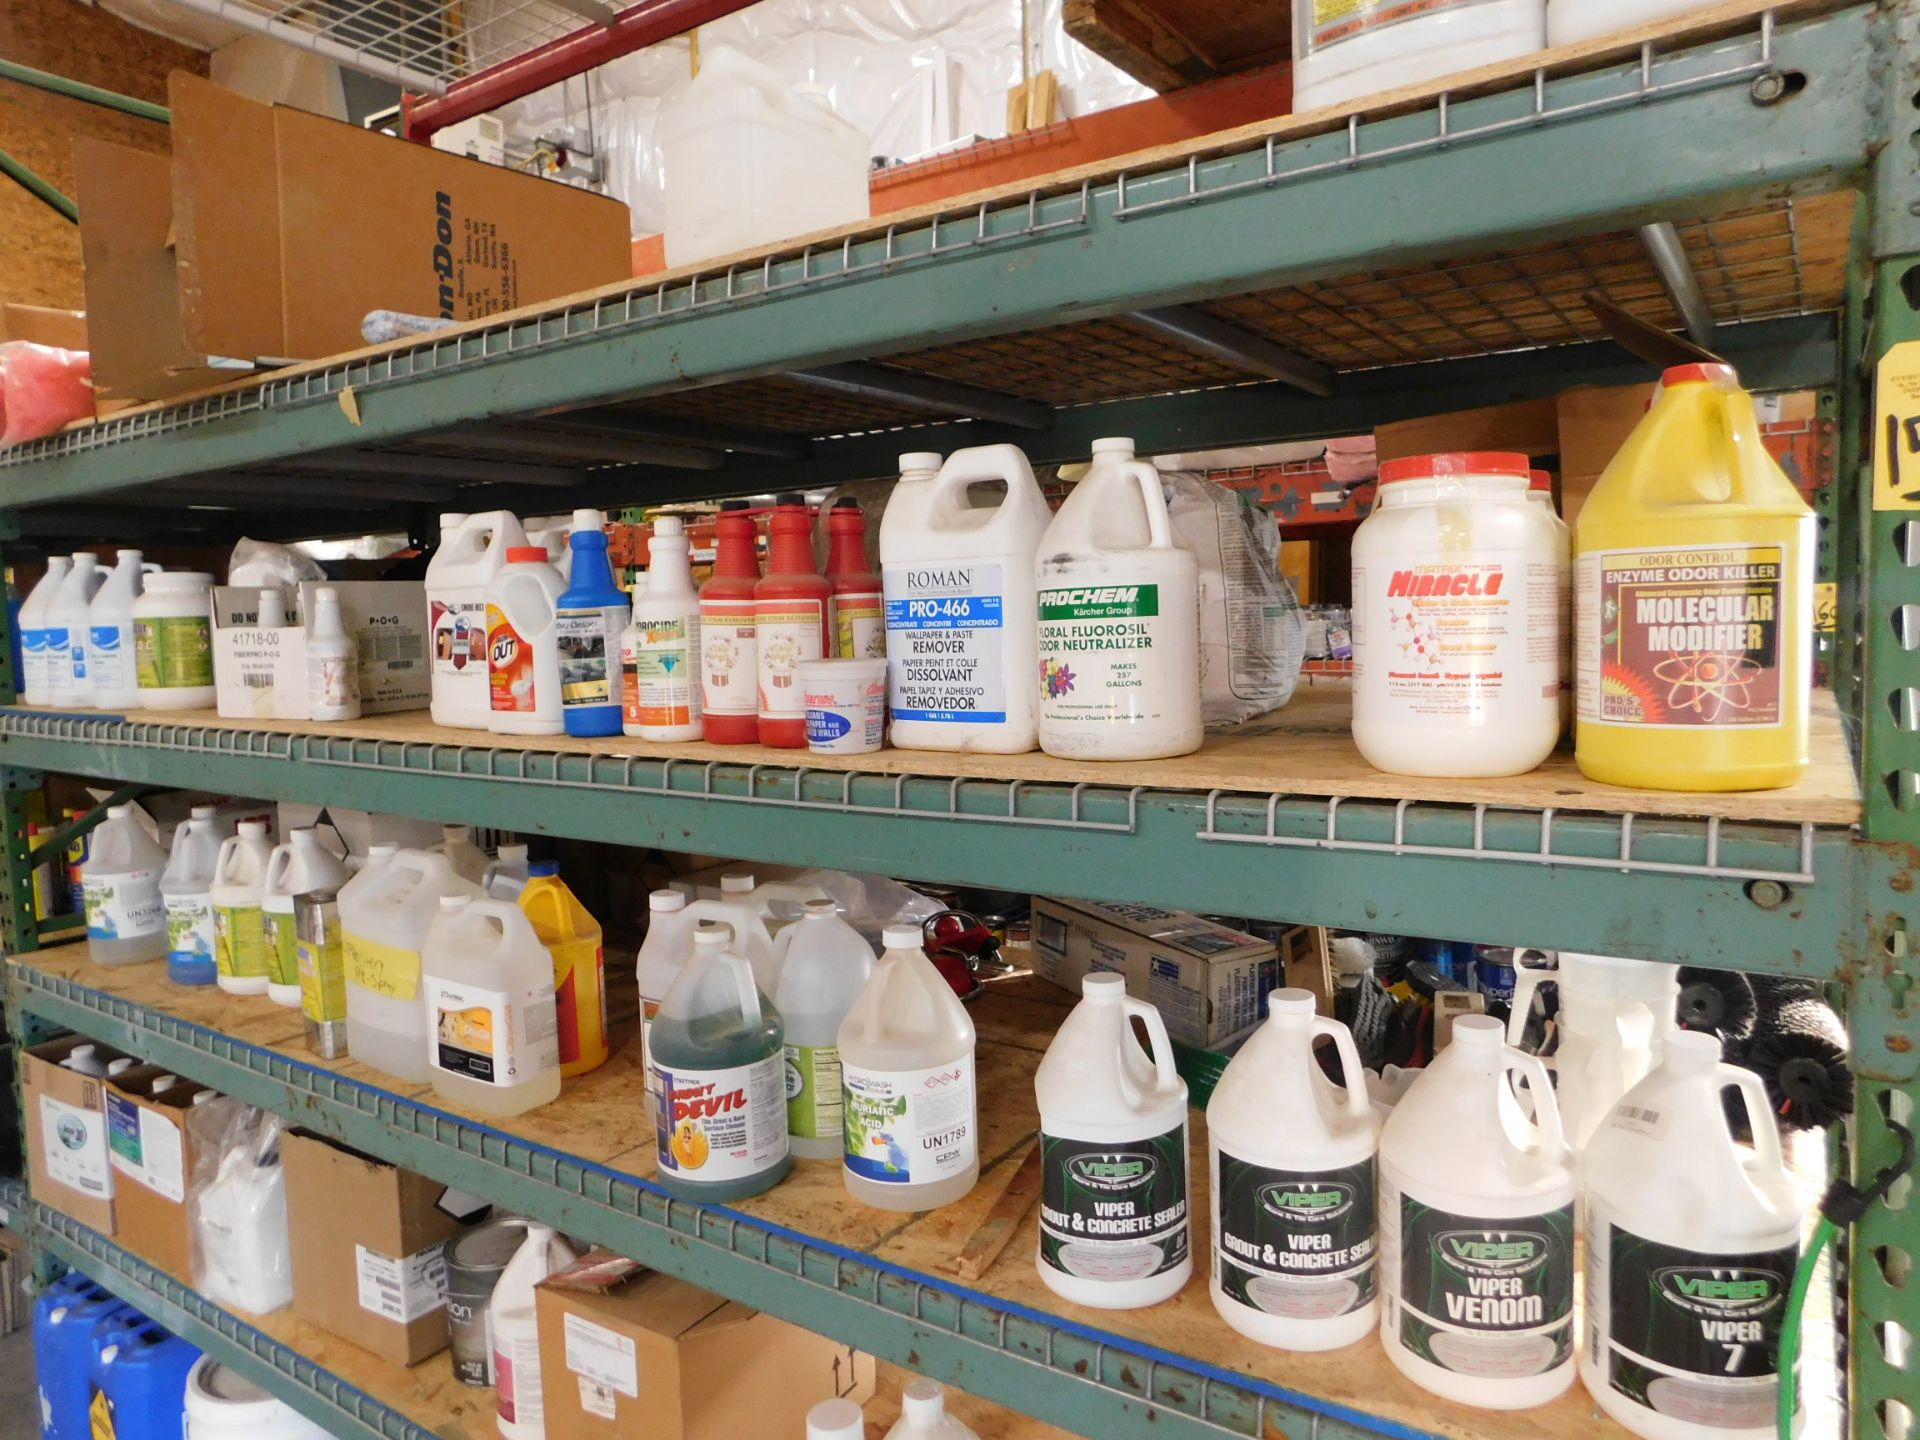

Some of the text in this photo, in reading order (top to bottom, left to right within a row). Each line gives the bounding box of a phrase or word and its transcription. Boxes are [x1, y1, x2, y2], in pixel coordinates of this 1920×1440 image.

[1639, 551, 1739, 567] ODOR CONTROL
[907, 569, 970, 588] ROMAN
[1606, 565, 1776, 584] ENZYME ODOR KILLER
[1039, 587, 1139, 607] PROCHEM
[909, 599, 970, 617] PRO-466
[1106, 606, 1133, 616] Group
[1636, 595, 1774, 624] MOLECULAR
[231, 612, 243, 624] DO
[785, 614, 818, 622] REMOVER
[232, 632, 279, 646] 41718-00
[905, 630, 973, 639] WALLPAPER & PASTE
[1072, 623, 1147, 638] FLUOROSIL
[1648, 624, 1763, 652] MODIFIER
[493, 639, 516, 661] OUT
[913, 641, 965, 653] REMOVER
[1063, 637, 1153, 651] NEUTRALIZER
[902, 659, 978, 667] PAPIER PEINT ET COLLE
[907, 669, 973, 681] DISSOLVANT
[918, 687, 936, 695] TAPIZ
[938, 687, 943, 695] Y
[945, 687, 984, 696] ADHESIVO
[1106, 680, 1142, 688] GALLONS
[906, 696, 976, 710] REMOVEDOR
[1603, 705, 1641, 717] CHOICE
[818, 729, 841, 738] WALLS
[672, 1088, 748, 1121] DEVIL
[851, 1100, 895, 1117] MURIATIC
[860, 1118, 882, 1129] ACID
[923, 1126, 966, 1150] UN1789
[1078, 1160, 1144, 1177] VIPER
[1270, 1190, 1341, 1208] VIPER
[1071, 1211, 1085, 1232] &
[1087, 1215, 1153, 1235] CONCRETE
[1154, 1199, 1186, 1228] SEALER
[1094, 1201, 1135, 1217] VIPER
[1224, 1231, 1261, 1261] GROUT
[1262, 1244, 1277, 1265] &
[1279, 1247, 1349, 1269] CONCRETE
[1287, 1233, 1332, 1250] VIPER
[1449, 1238, 1535, 1259] VIPER
[1467, 1277, 1523, 1296] VIPER
[1672, 1274, 1769, 1298] VIPER
[1445, 1291, 1544, 1325] VENOM
[1700, 1319, 1763, 1342] VIPER
[1722, 1343, 1746, 1374] 7
